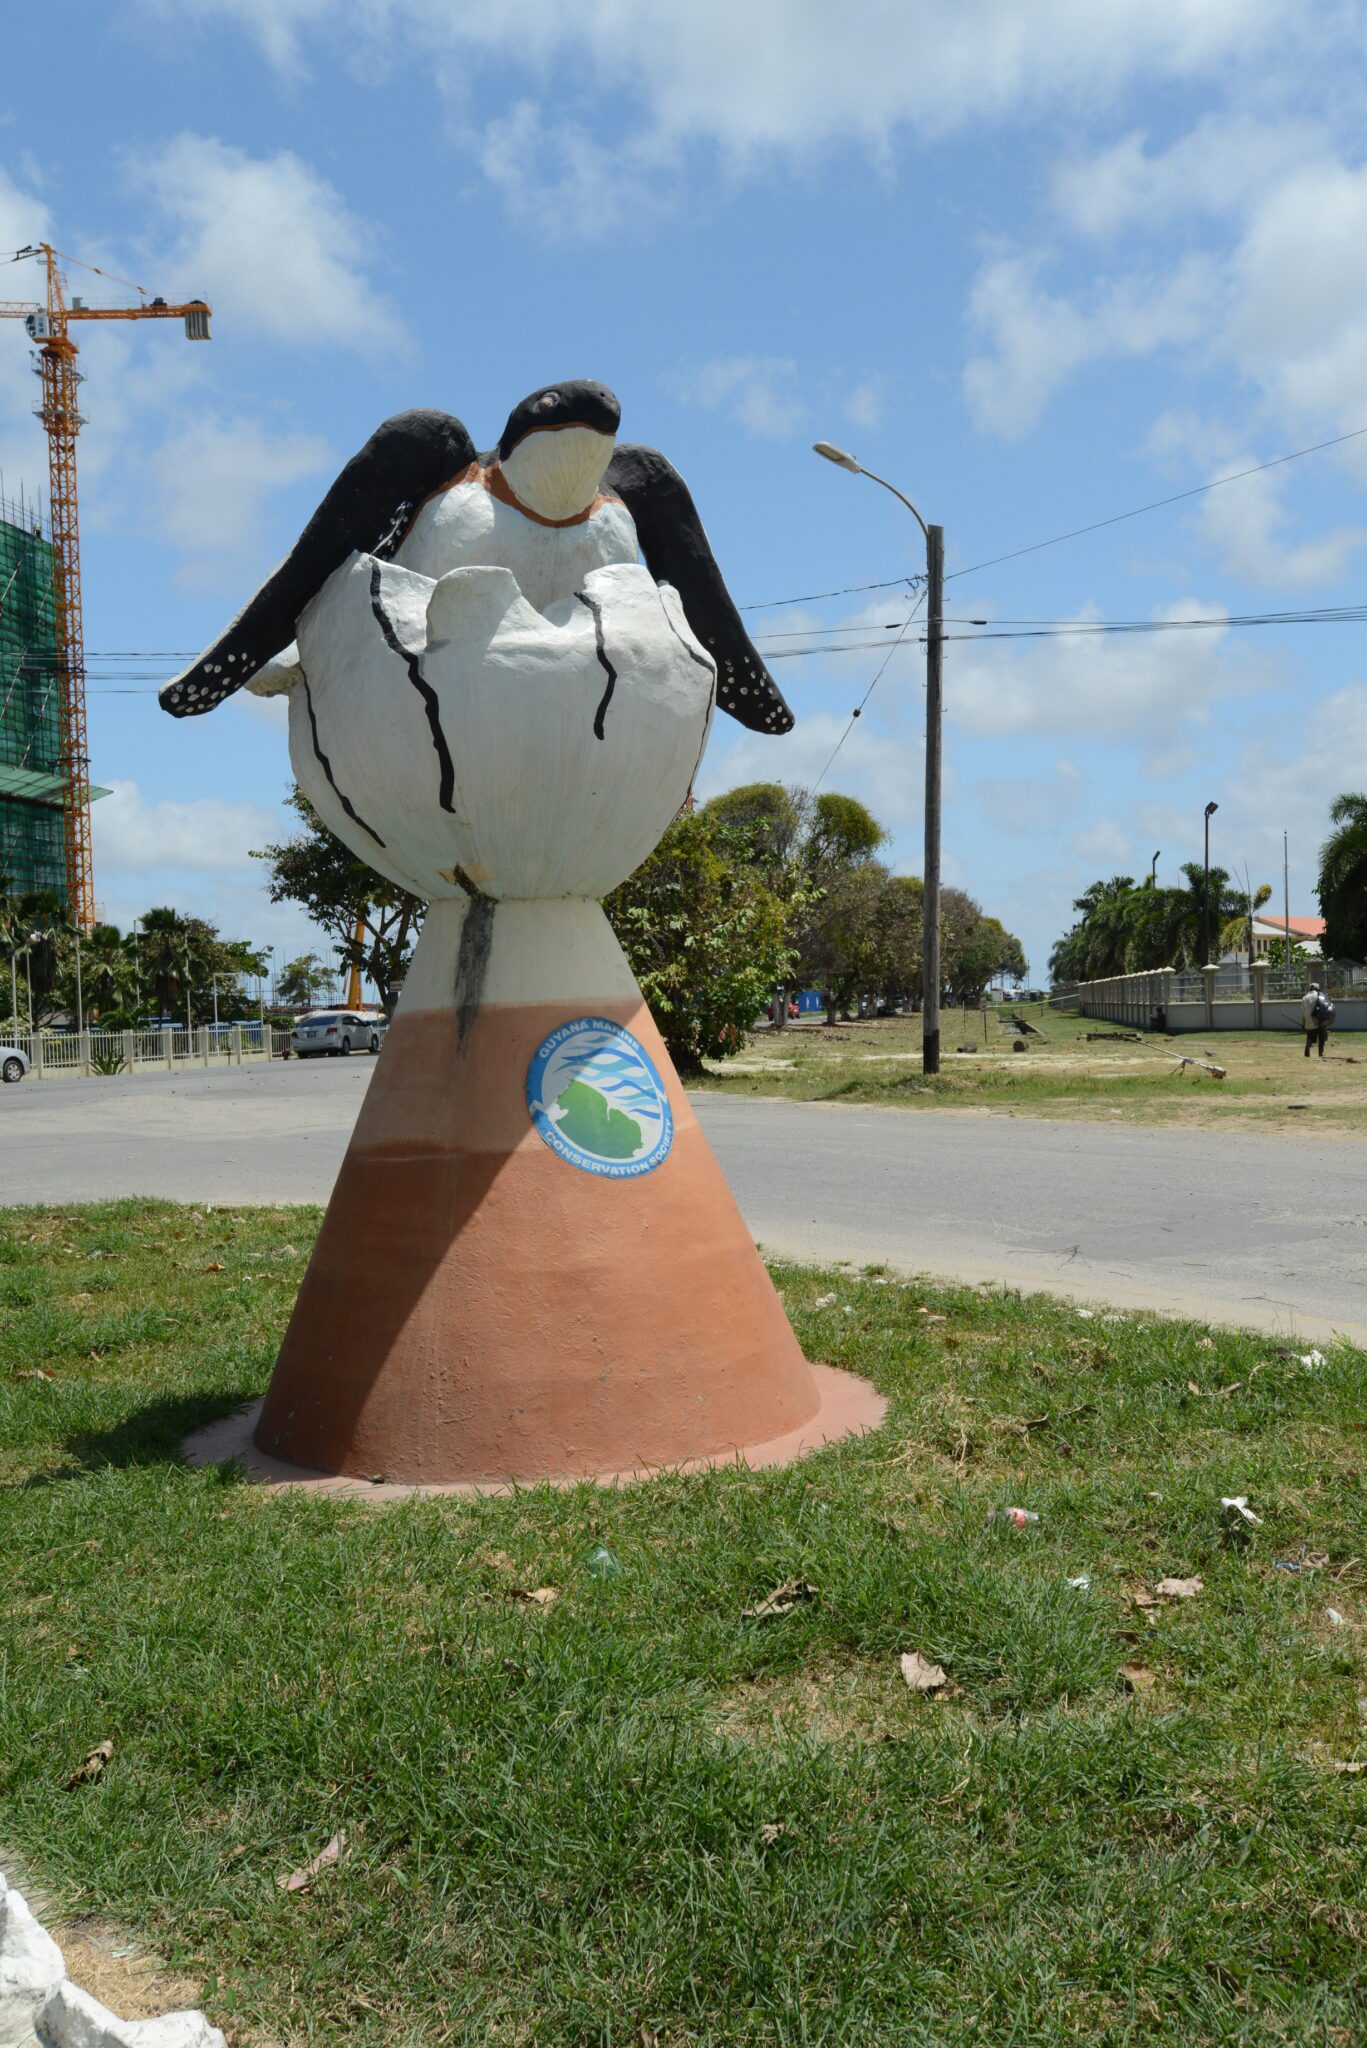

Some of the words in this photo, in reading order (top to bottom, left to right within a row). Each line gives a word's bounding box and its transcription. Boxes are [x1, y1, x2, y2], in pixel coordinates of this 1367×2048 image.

[539, 1020, 589, 1058] GUYANA
[593, 1020, 641, 1051] MARINE
[545, 1131, 650, 1176] CONSERVATION
[648, 1119, 673, 1166] SOCIETY
